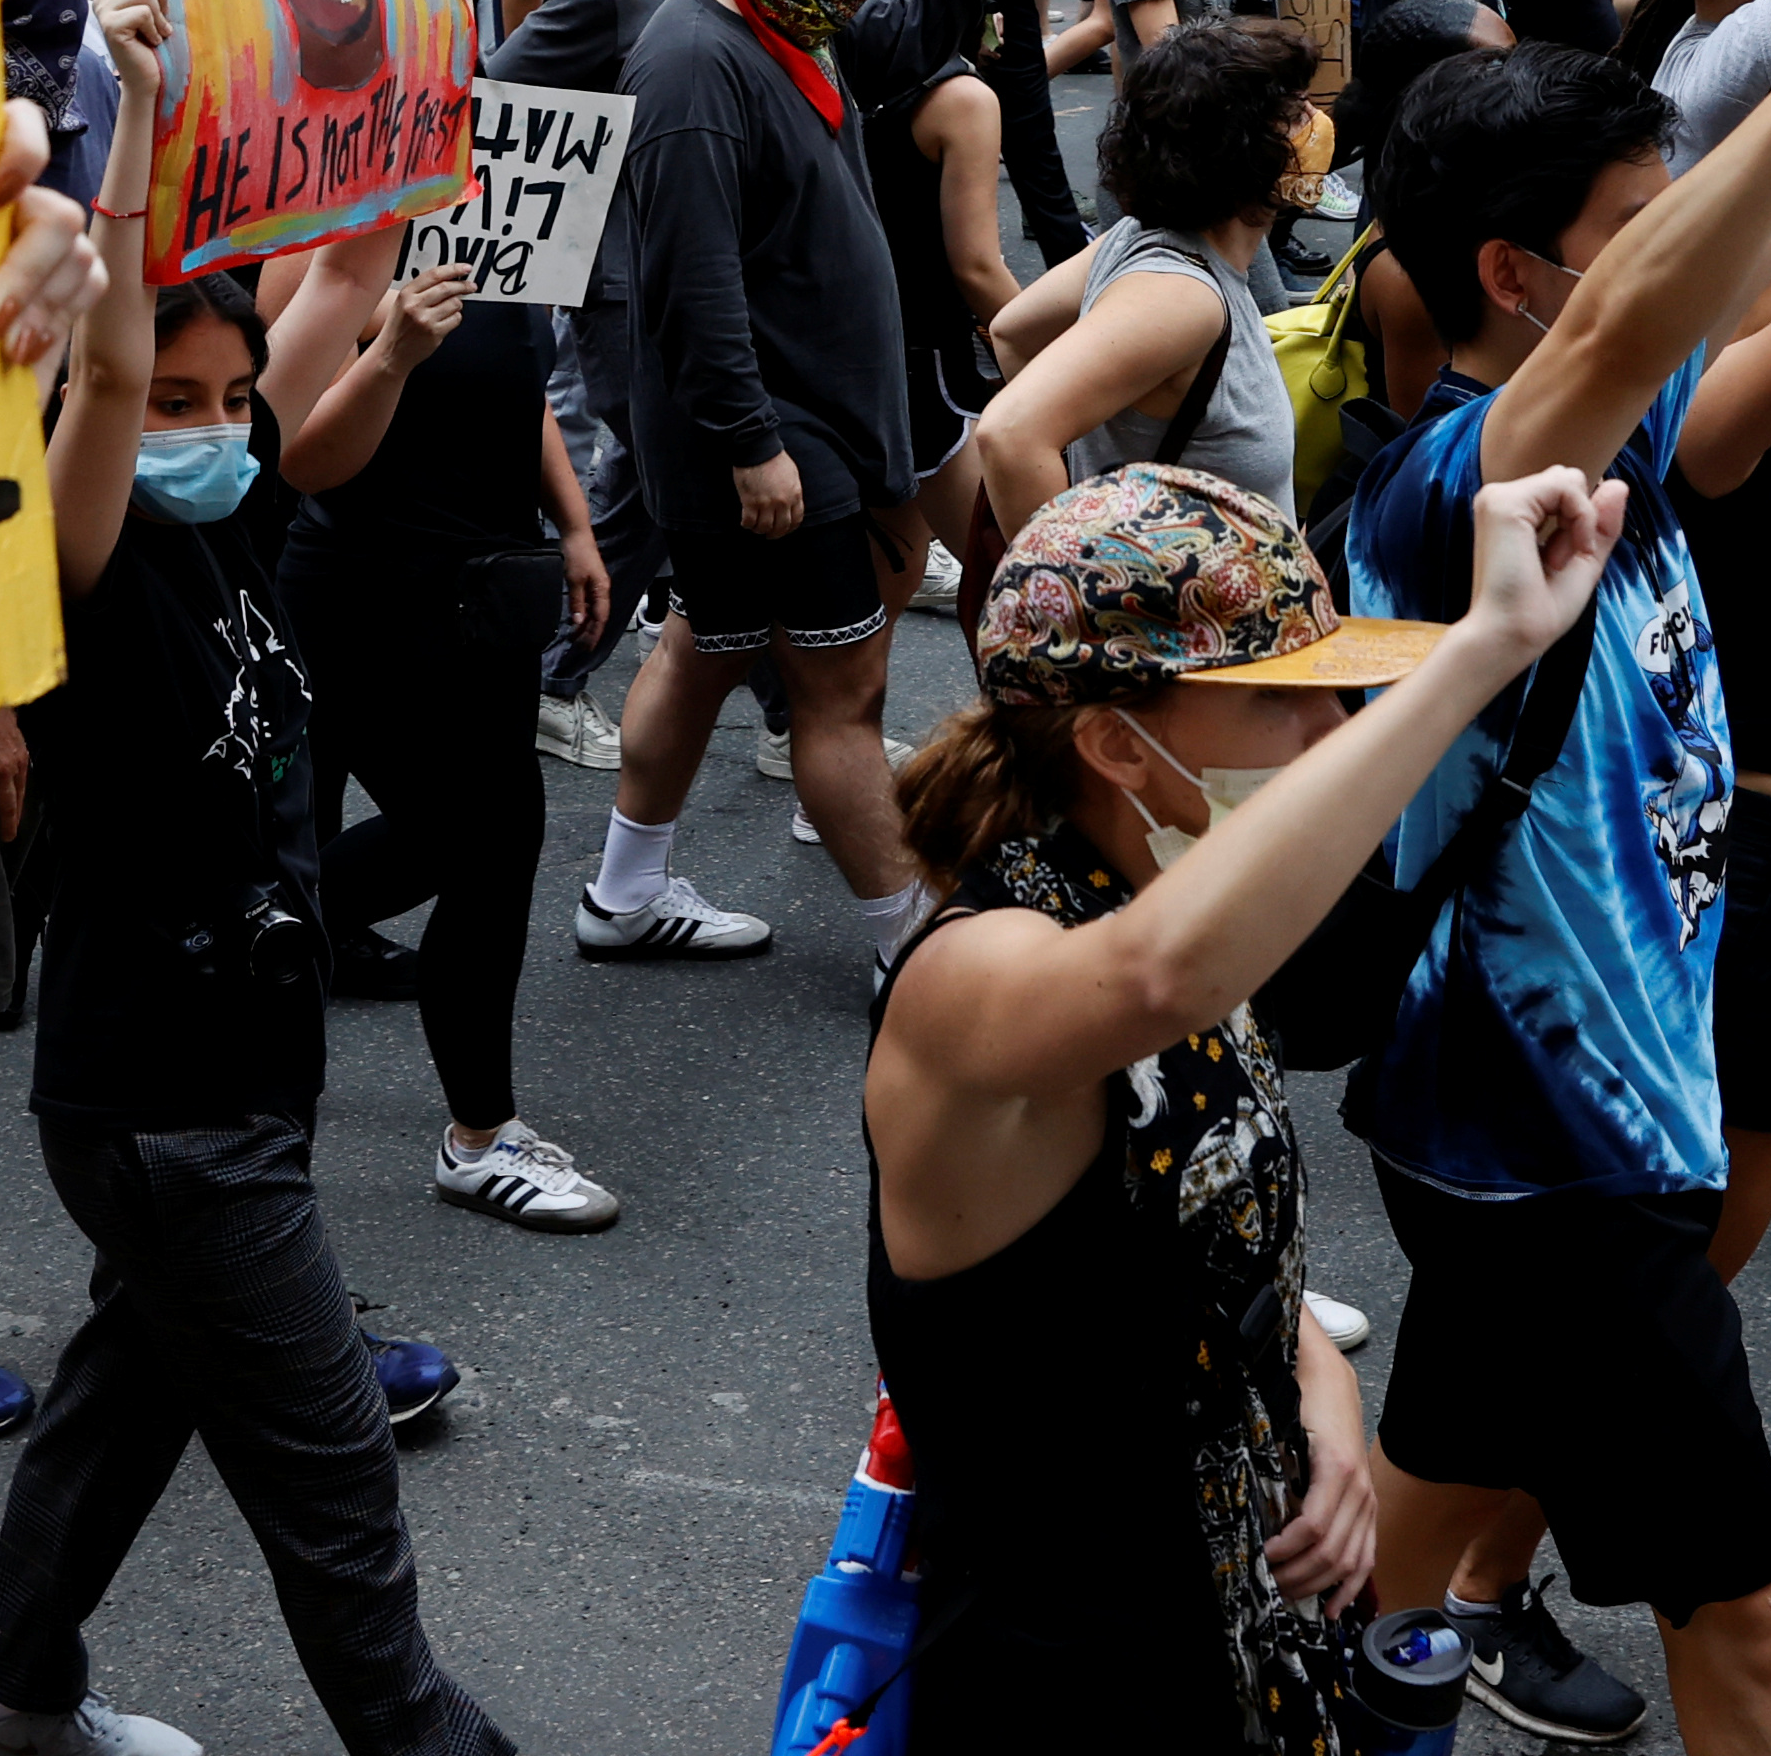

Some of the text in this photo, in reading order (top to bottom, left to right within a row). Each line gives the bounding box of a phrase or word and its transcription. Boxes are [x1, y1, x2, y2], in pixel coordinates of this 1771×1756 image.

[182, 126, 252, 252] HE
[264, 115, 310, 211] IS
[366, 73, 408, 176] THE
[401, 85, 468, 187] FIRST
[246, 900, 270, 920] Canon
